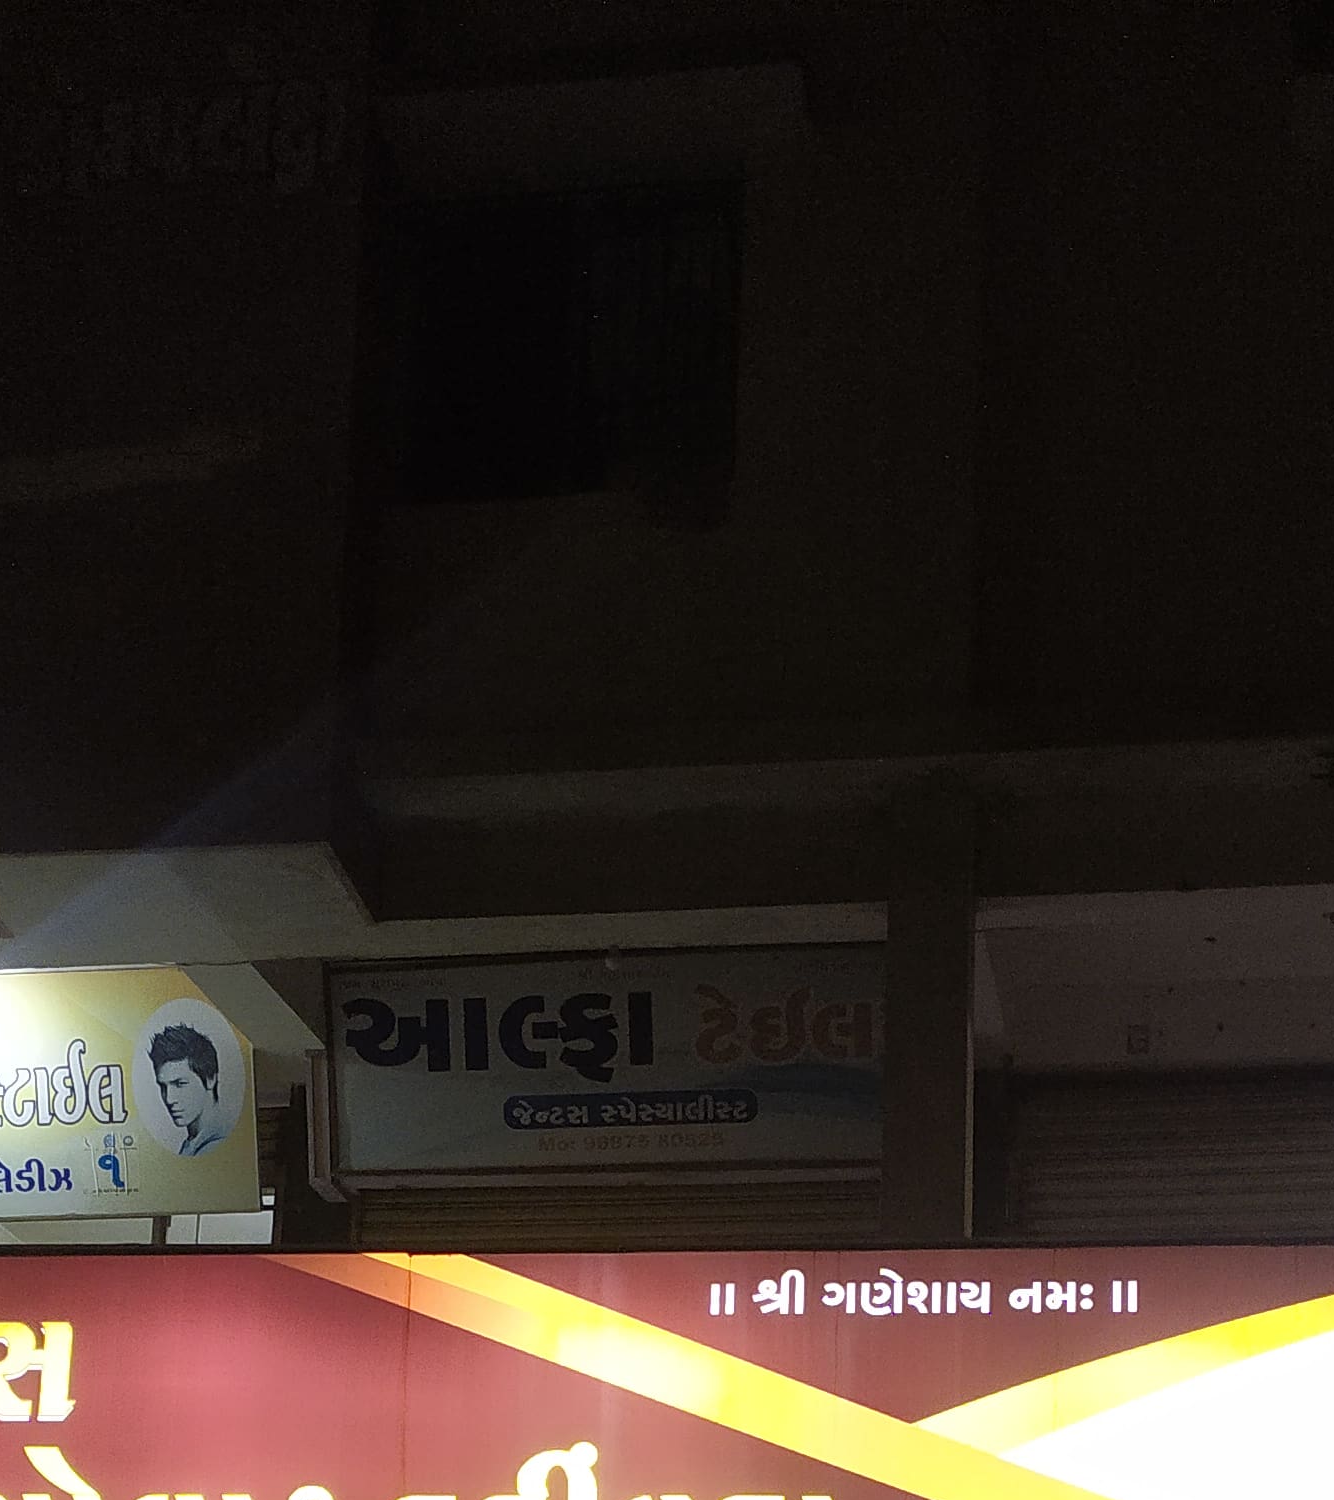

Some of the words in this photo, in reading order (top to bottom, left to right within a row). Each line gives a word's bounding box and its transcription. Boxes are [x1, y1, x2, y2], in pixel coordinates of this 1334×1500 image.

[345, 991, 654, 1083] આલ્ફા
[751, 1269, 805, 1316] શ્રી
[821, 1267, 992, 1316] ગણેશાય
